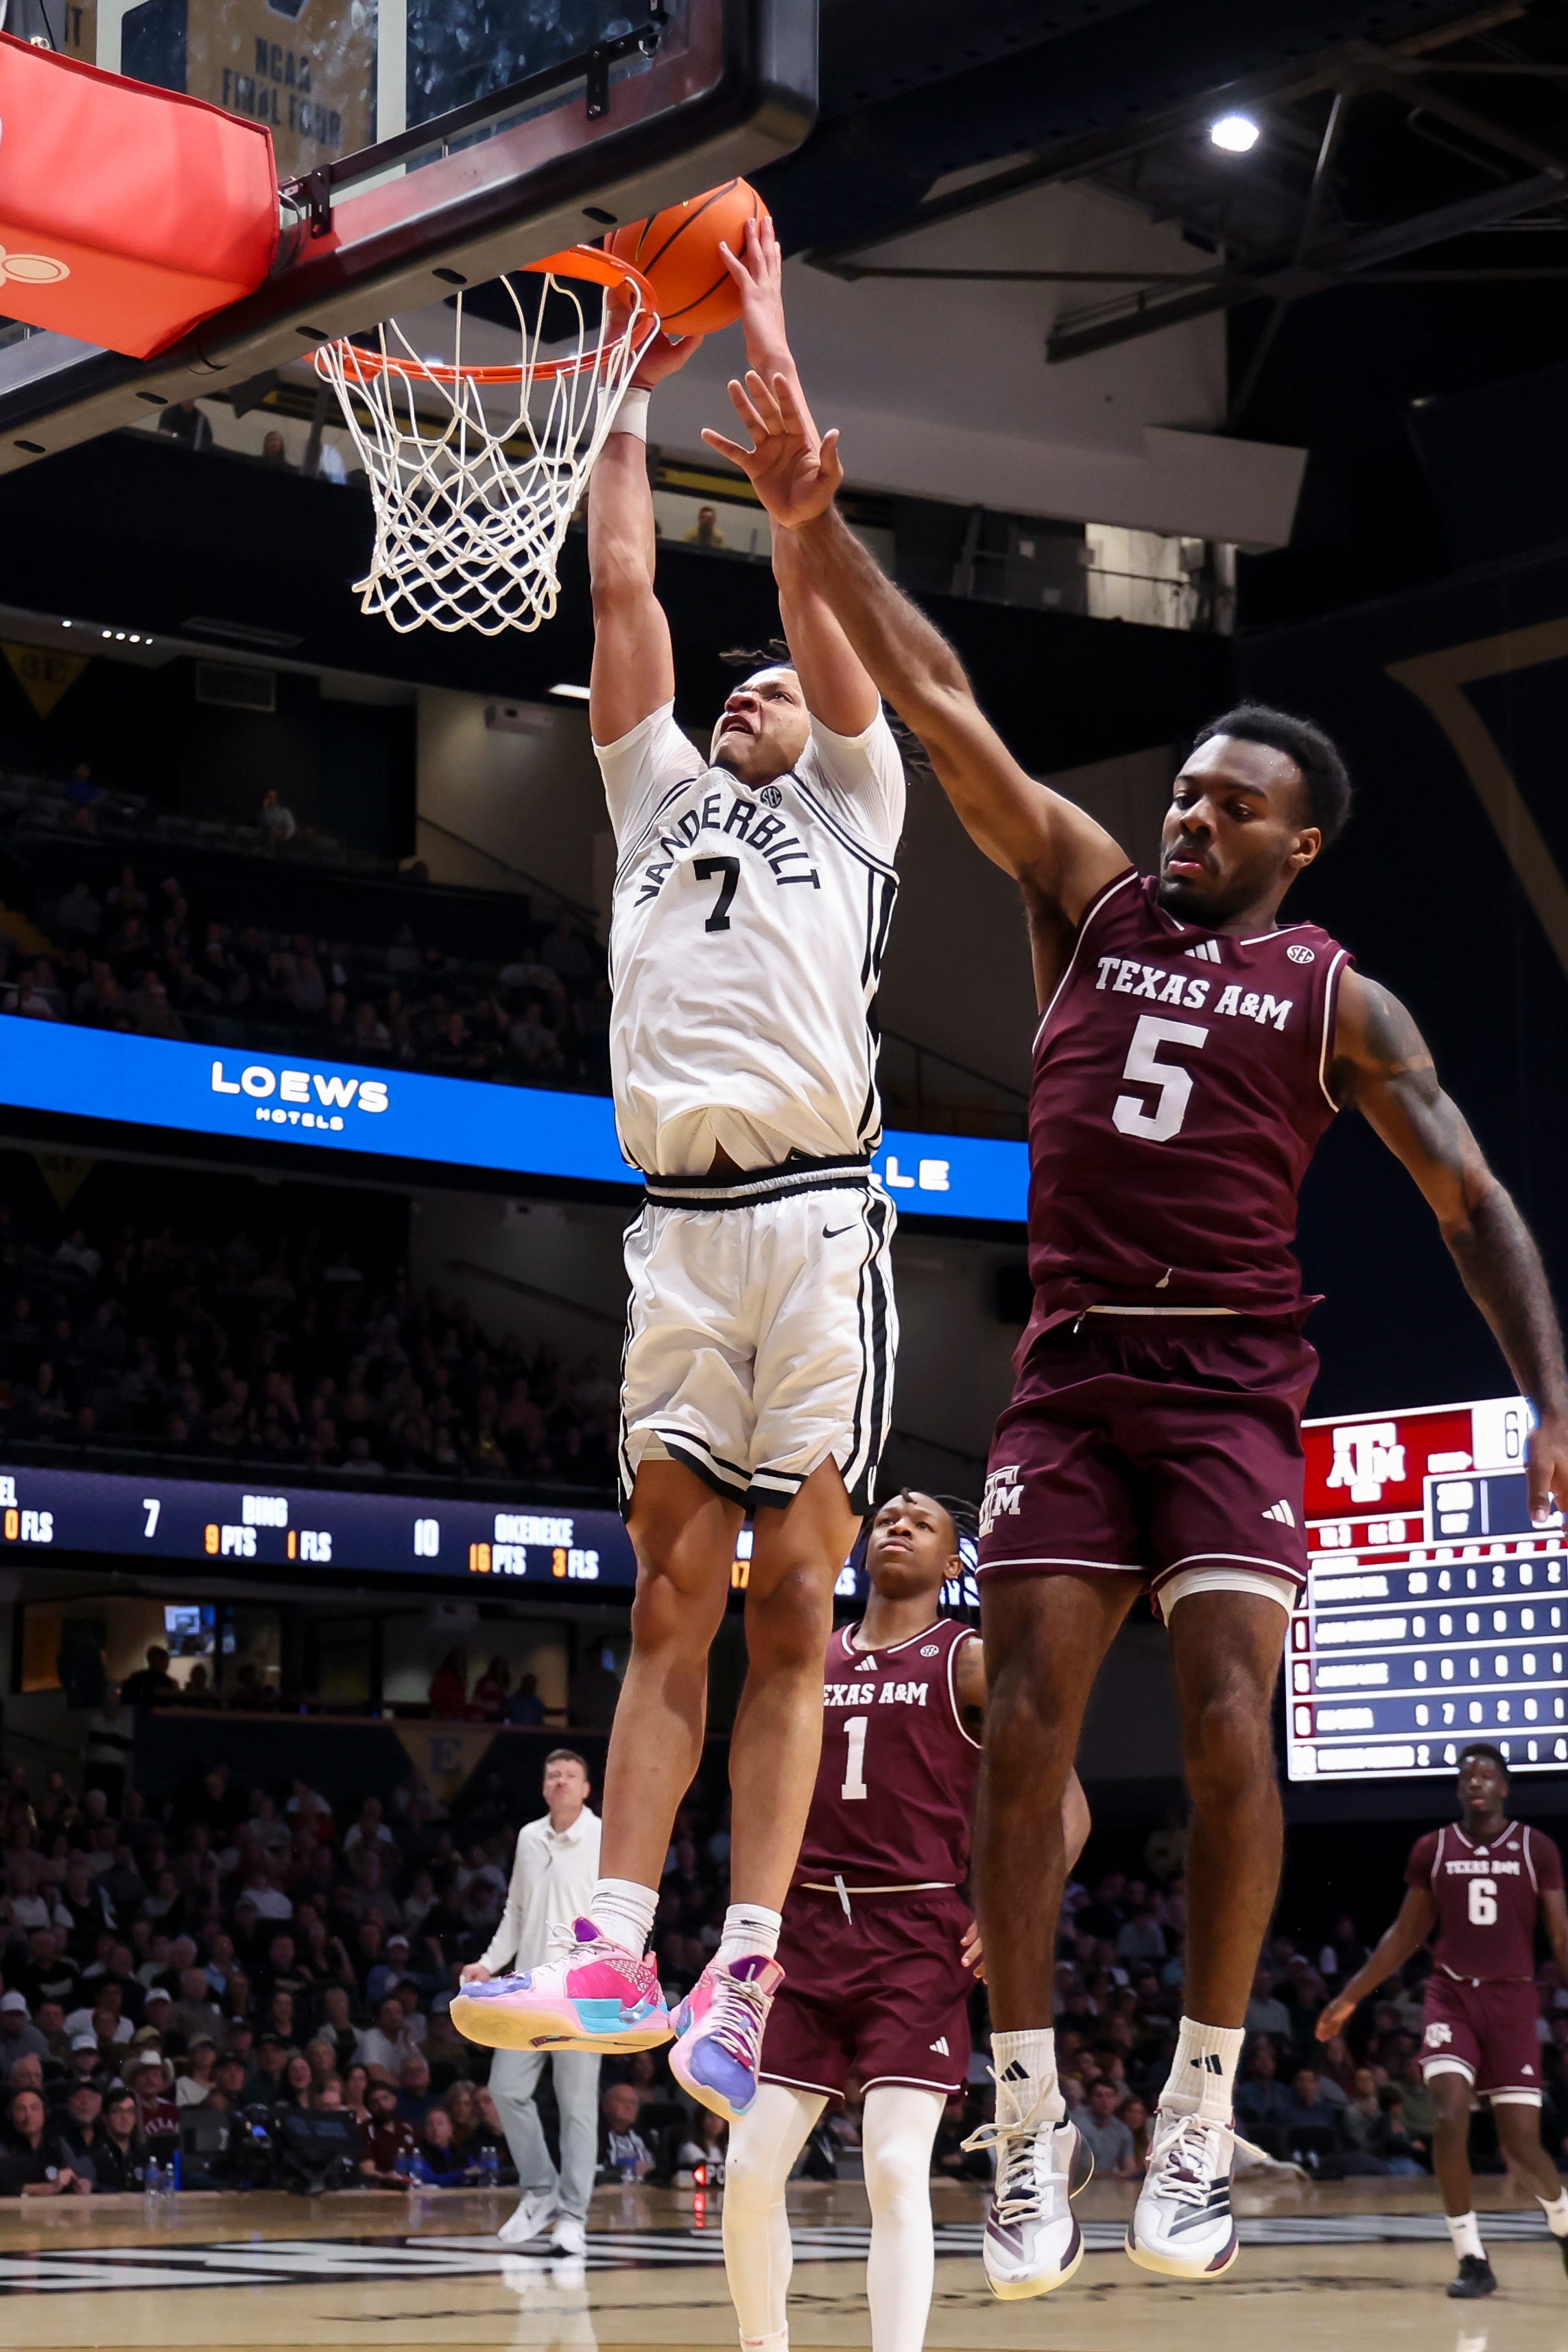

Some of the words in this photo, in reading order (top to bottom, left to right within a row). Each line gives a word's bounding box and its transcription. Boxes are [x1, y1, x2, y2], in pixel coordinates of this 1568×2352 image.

[255, 36, 311, 94] NCAA
[223, 67, 280, 126] FINAL
[289, 95, 341, 150] FOUR
[761, 787, 782, 808] SEC
[634, 792, 821, 908] VANDERBILT
[692, 856, 739, 933] 7
[1287, 946, 1314, 963] SEC
[1095, 958, 1209, 1009] TEXAS
[1214, 985, 1294, 1031] A&M
[211, 1060, 389, 1113] LOEWS
[1112, 1014, 1209, 1142] 5
[255, 1107, 344, 1131] HOTELS
[868, 1156, 951, 1191] LE
[21, 1510, 54, 1543] FLS
[143, 1498, 161, 1538] 7
[414, 1518, 440, 1557] 10
[205, 1523, 219, 1554] 9
[221, 1525, 257, 1557] PTS
[287, 1530, 297, 1560] 1
[300, 1530, 332, 1563] FLS
[468, 1543, 491, 1573] 16
[492, 1544, 527, 1576] PTS
[552, 1548, 566, 1578] 3
[567, 1549, 599, 1580] FLS
[823, 1683, 875, 1706] EXAS
[878, 1682, 929, 1706] A&M
[841, 1716, 868, 1799] 1
[1468, 1878, 1497, 1925] 6
